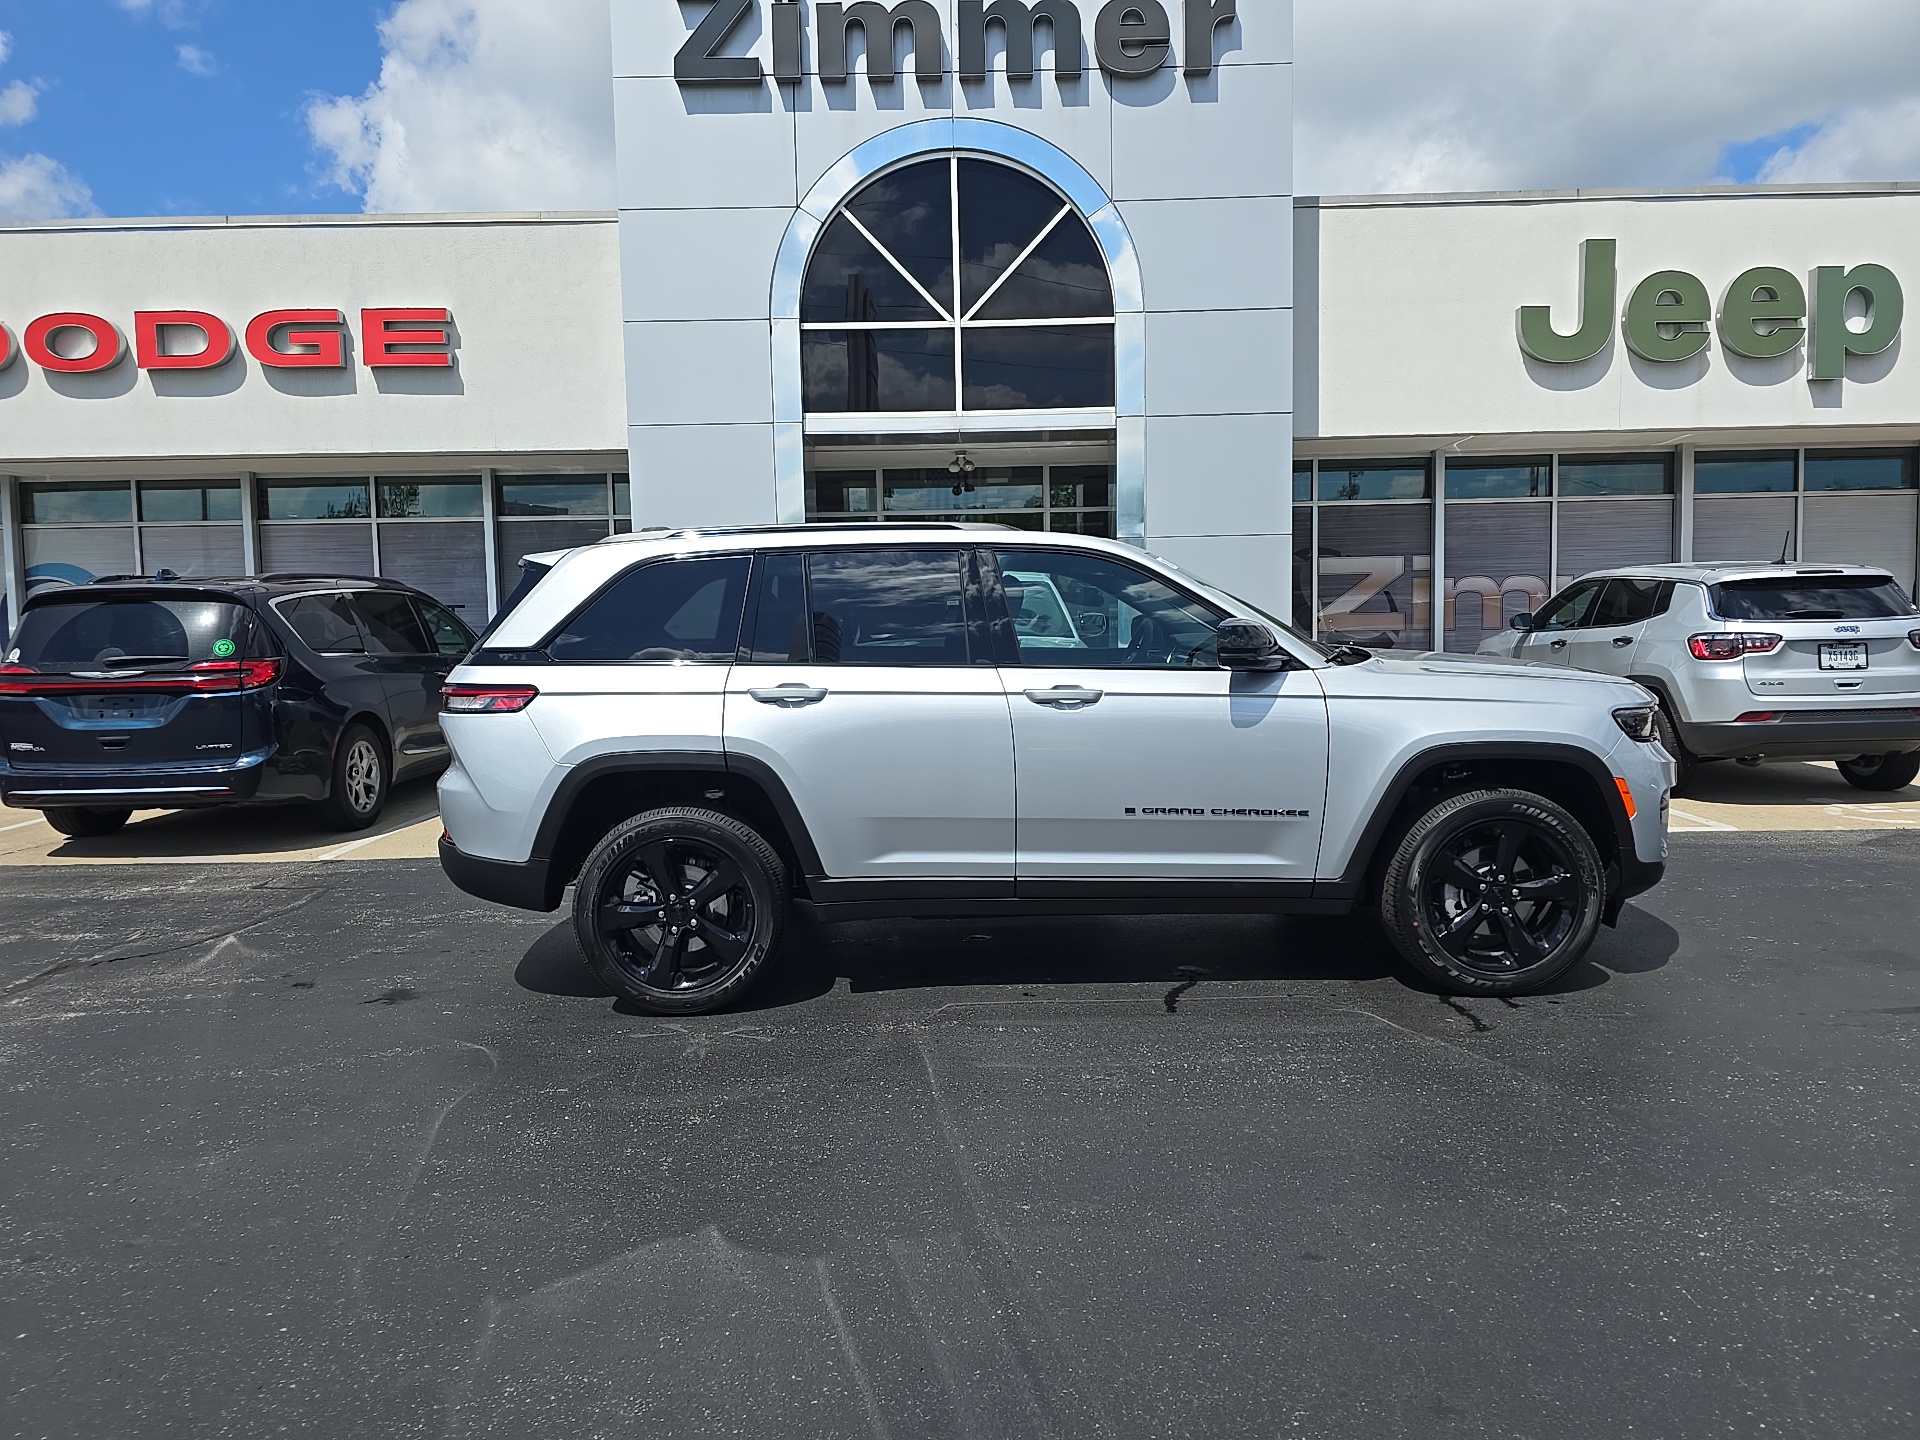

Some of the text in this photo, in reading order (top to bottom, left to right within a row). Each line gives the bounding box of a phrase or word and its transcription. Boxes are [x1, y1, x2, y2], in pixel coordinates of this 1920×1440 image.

[674, 0, 1236, 84] Zimmer
[1515, 238, 1905, 381] Jeep
[0, 308, 454, 374] ODGE
[1834, 625, 1861, 634] Jeep
[1828, 650, 1859, 662] X5143G
[1141, 807, 1205, 816] GRAND
[1210, 808, 1310, 818] CHEROKEE
